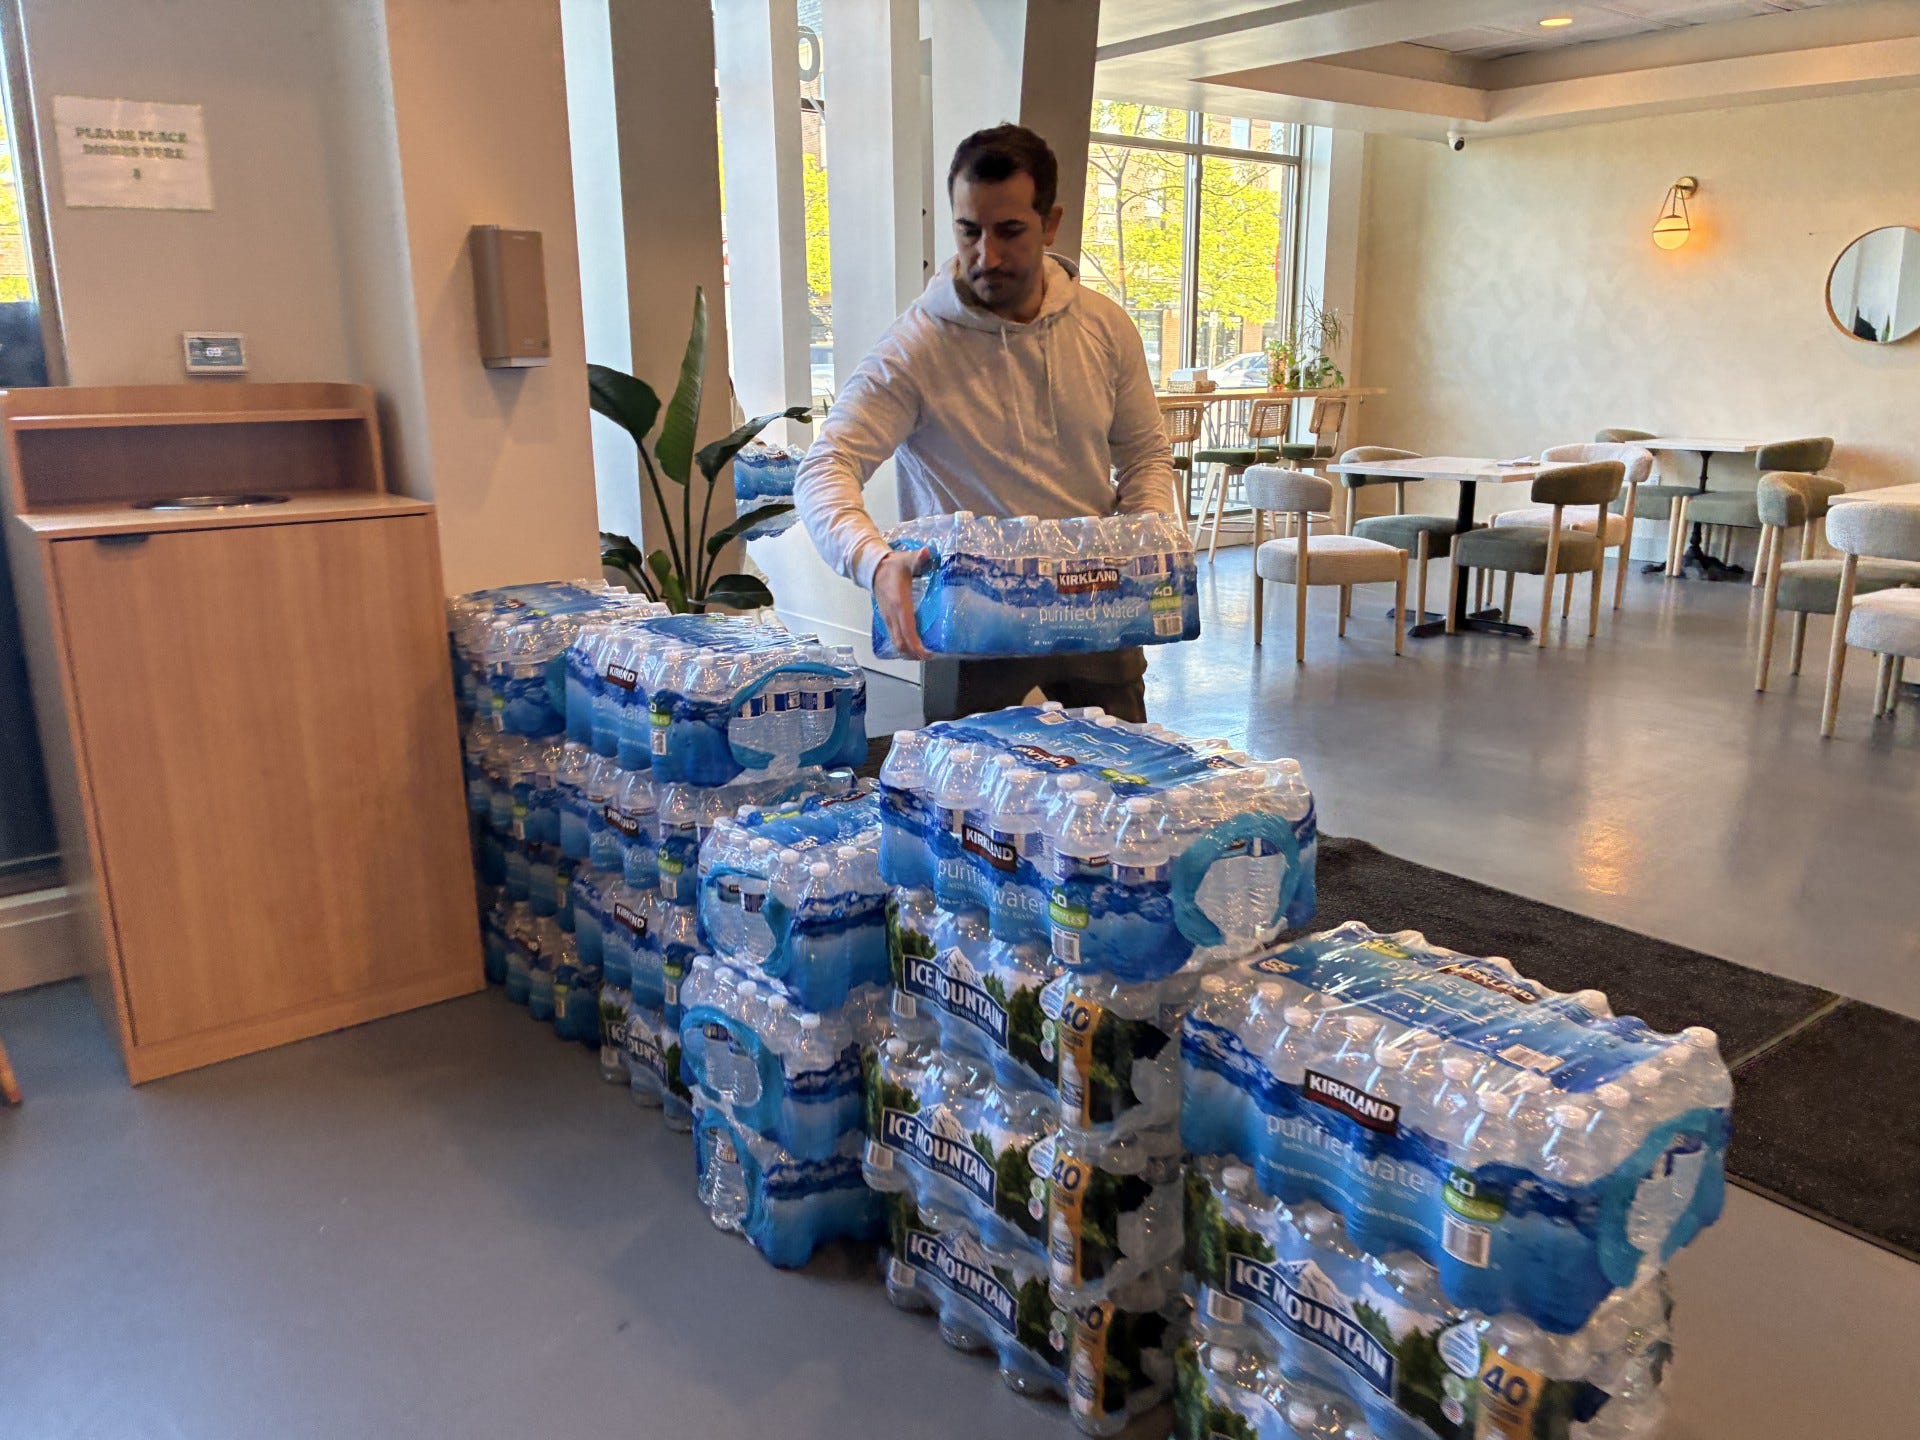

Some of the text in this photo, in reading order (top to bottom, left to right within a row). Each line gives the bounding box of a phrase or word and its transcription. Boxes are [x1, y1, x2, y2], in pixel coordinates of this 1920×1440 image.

[1059, 570, 1119, 586] KIRKLAND
[1153, 585, 1173, 597] 40
[1039, 602, 1141, 624] purified water
[937, 858, 991, 892] purifie
[992, 886, 1044, 916] water
[909, 959, 935, 990] ICE
[934, 967, 1004, 1036] MOUNTAIN
[1060, 1000, 1091, 1033] 40
[1308, 1073, 1396, 1123] KIRKLAND
[888, 1112, 916, 1143] ICE
[914, 1122, 991, 1194] MOUNTAIN
[1052, 1158, 1082, 1191] 40
[910, 1233, 936, 1263] ICE
[936, 1245, 1013, 1320] MOUNTAIN
[1235, 1258, 1272, 1297] ICE
[1272, 1276, 1389, 1380] MOUNTAIN
[1482, 1364, 1529, 1406] 40
